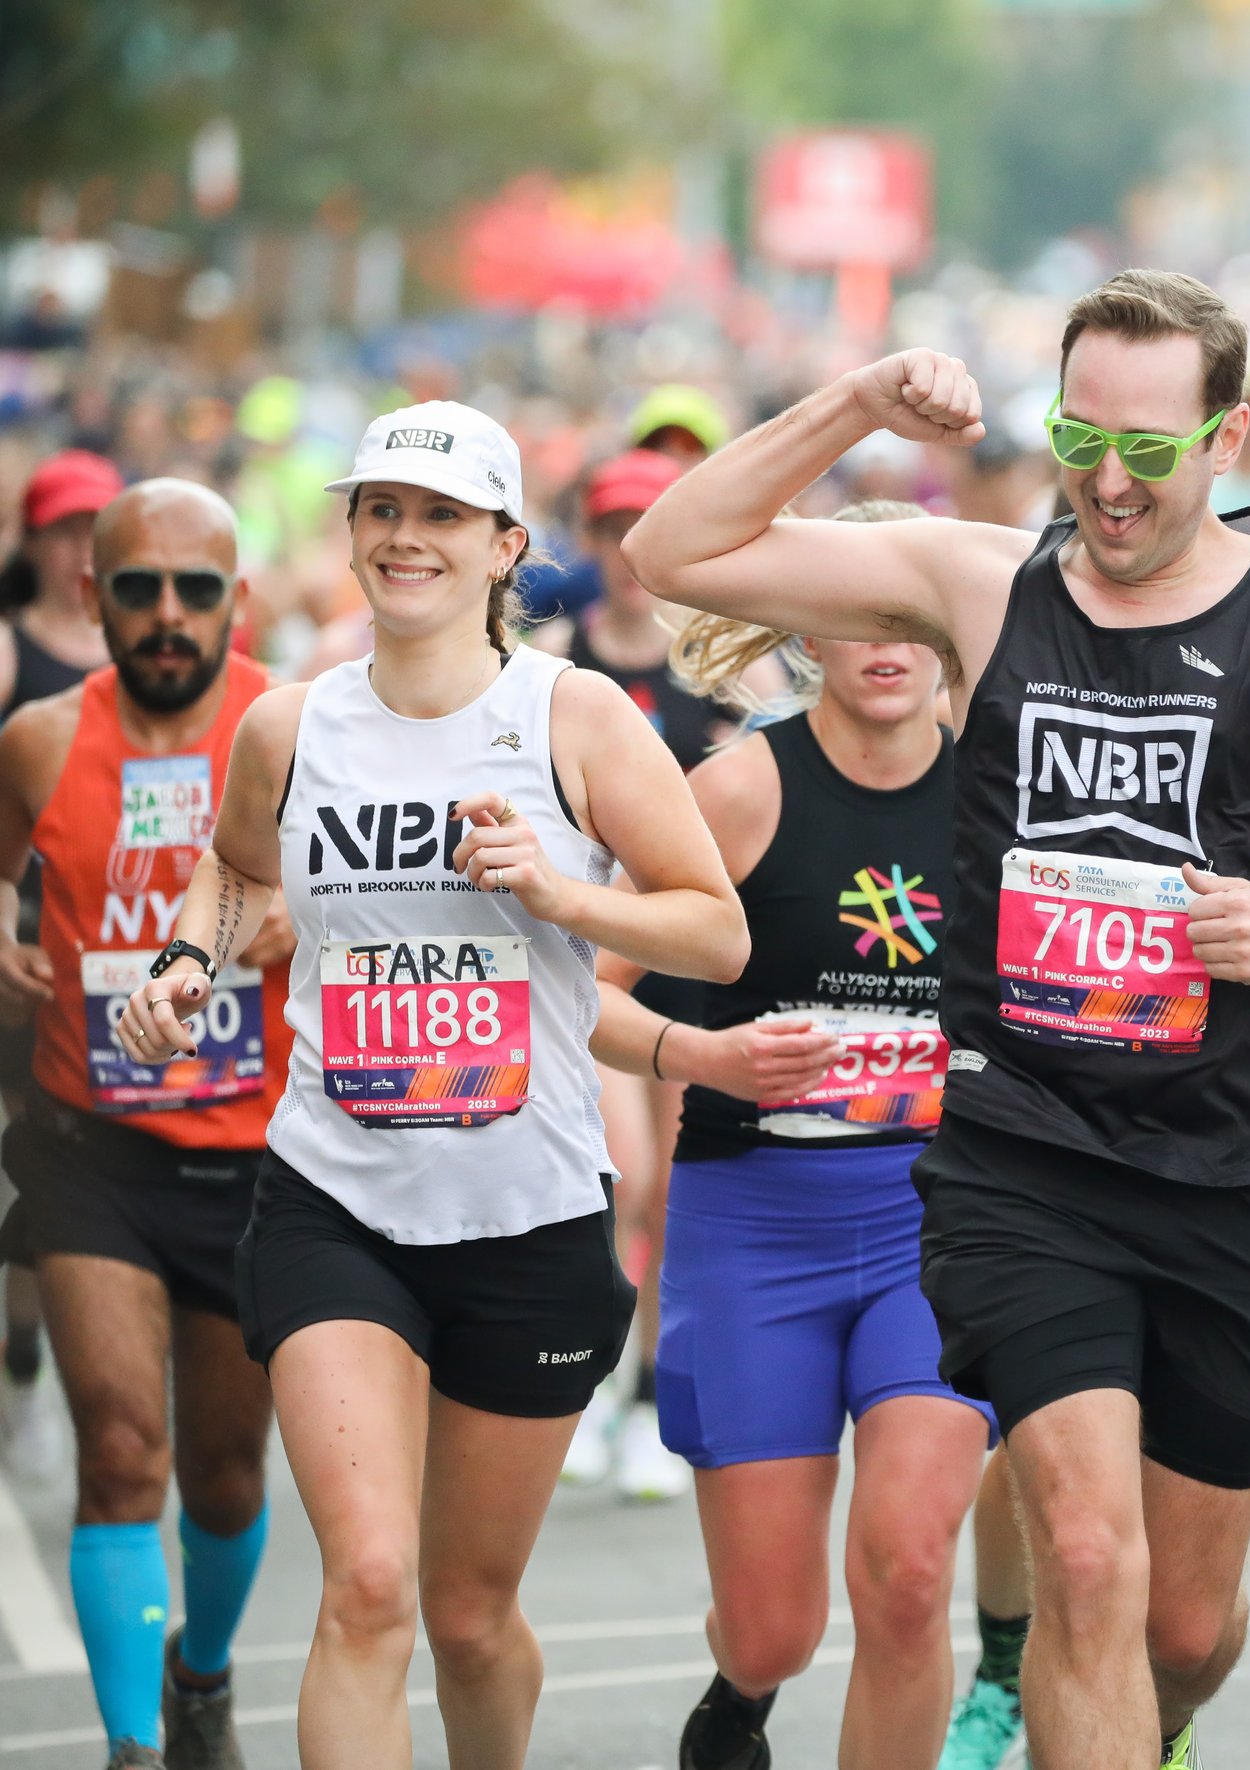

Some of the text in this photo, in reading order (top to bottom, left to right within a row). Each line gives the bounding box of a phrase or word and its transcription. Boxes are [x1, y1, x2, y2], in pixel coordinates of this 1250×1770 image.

[391, 430, 447, 450] NBR
[488, 471, 505, 493] ciele
[1026, 682, 1217, 709] NORTH BROOKLYN RUNNERS
[1038, 731, 1186, 804] NBR
[1030, 860, 1070, 890] tcs
[1078, 866, 1104, 875] TATA
[311, 883, 351, 897] NORTH
[359, 881, 435, 893] BROOKLYN
[1076, 876, 1140, 890] CONSULTANCY
[1076, 885, 1116, 896] SERVICES
[1155, 895, 1186, 906] TATA
[1034, 901, 1174, 974] 7105
[350, 943, 487, 984] TARA
[818, 971, 942, 988] ALLYSON WHITN
[1003, 963, 1124, 989] WAVE 1 PINK CORRAL C
[347, 988, 501, 1048] 11188
[1024, 1011, 1112, 1032] #TCSNYCMarathon
[1140, 1028, 1170, 1038] 2023
[1132, 1042, 1142, 1052] B
[329, 1052, 446, 1066] WAVE 1 PINK CORRAL E
[353, 1100, 497, 1112] #TCSNYCMarathon 2023
[462, 1114, 472, 1126] B
[551, 1350, 593, 1364] BANDIT
